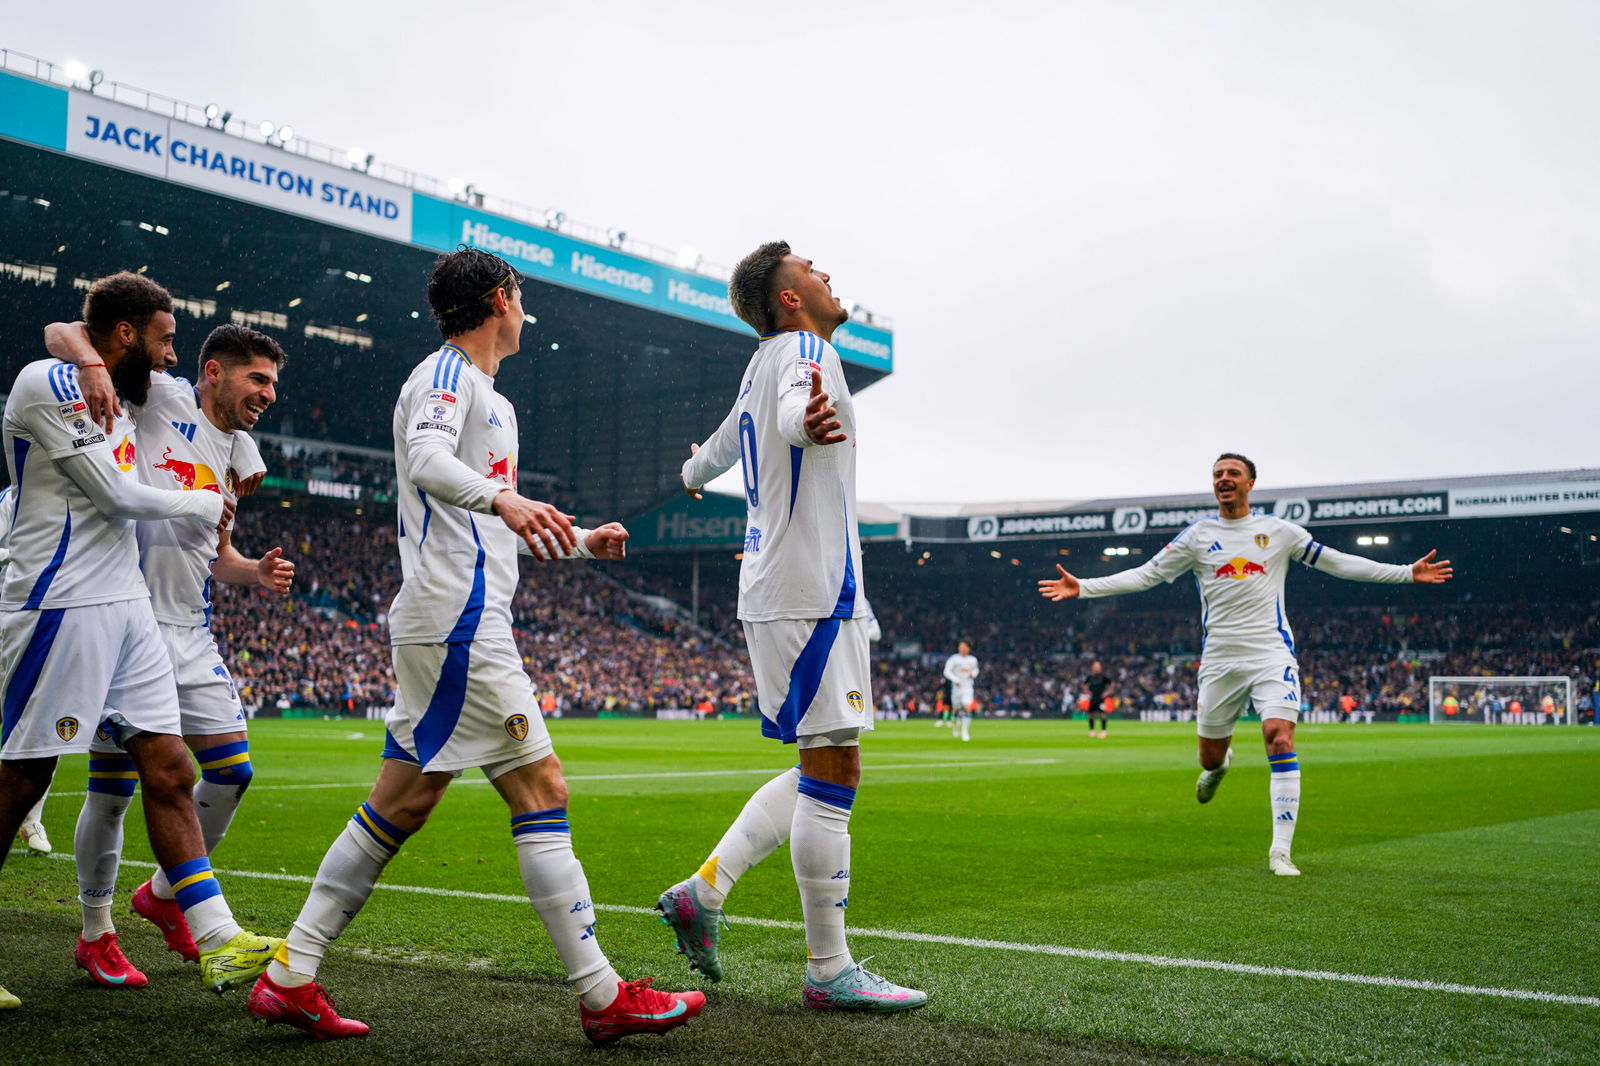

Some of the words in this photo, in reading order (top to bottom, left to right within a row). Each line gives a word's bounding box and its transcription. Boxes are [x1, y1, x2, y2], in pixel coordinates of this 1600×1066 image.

[85, 115, 162, 156] JACK
[170, 140, 313, 197] CHARLTON
[320, 183, 399, 221] STAND
[461, 219, 554, 267] Hisense
[571, 251, 654, 295] Hisense
[307, 479, 362, 500] UNIBET
[1455, 495, 1507, 507] NORMAN
[1511, 492, 1560, 504] HUNTER
[1313, 496, 1442, 519] JDSPORTS.COM
[656, 512, 747, 540] Hisen
[1000, 515, 1106, 534] JDSPORTS.COM
[1283, 666, 1296, 685] 4
